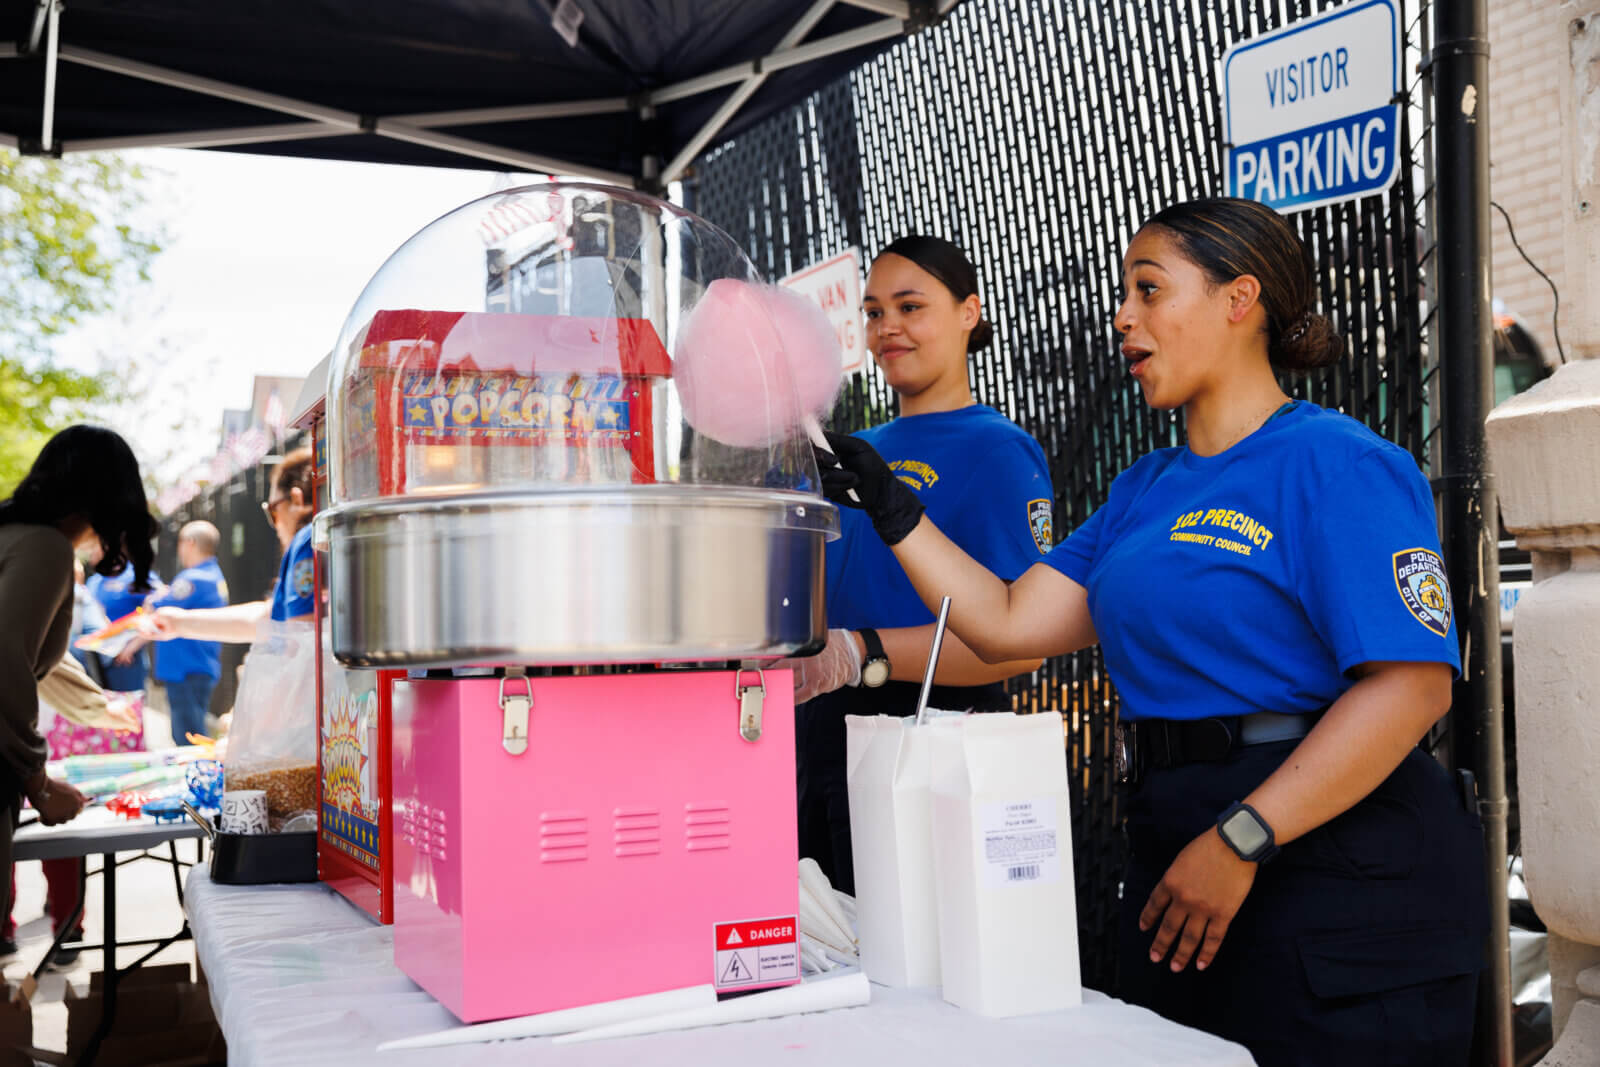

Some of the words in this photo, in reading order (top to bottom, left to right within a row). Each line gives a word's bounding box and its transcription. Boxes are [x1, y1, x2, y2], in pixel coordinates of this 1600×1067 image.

[1266, 47, 1349, 108] VISITOR
[1236, 116, 1386, 201] PARKING
[430, 390, 598, 431] POPCORN
[1169, 532, 1216, 546] COMMUNITY
[1215, 537, 1252, 556] COUNCIL
[1170, 510, 1203, 531] 102
[1201, 508, 1274, 551] PRECINCT
[1410, 552, 1440, 569] POLICE
[1402, 587, 1419, 609] CITY
[1418, 610, 1433, 622] OF
[750, 926, 793, 940] DANGER
